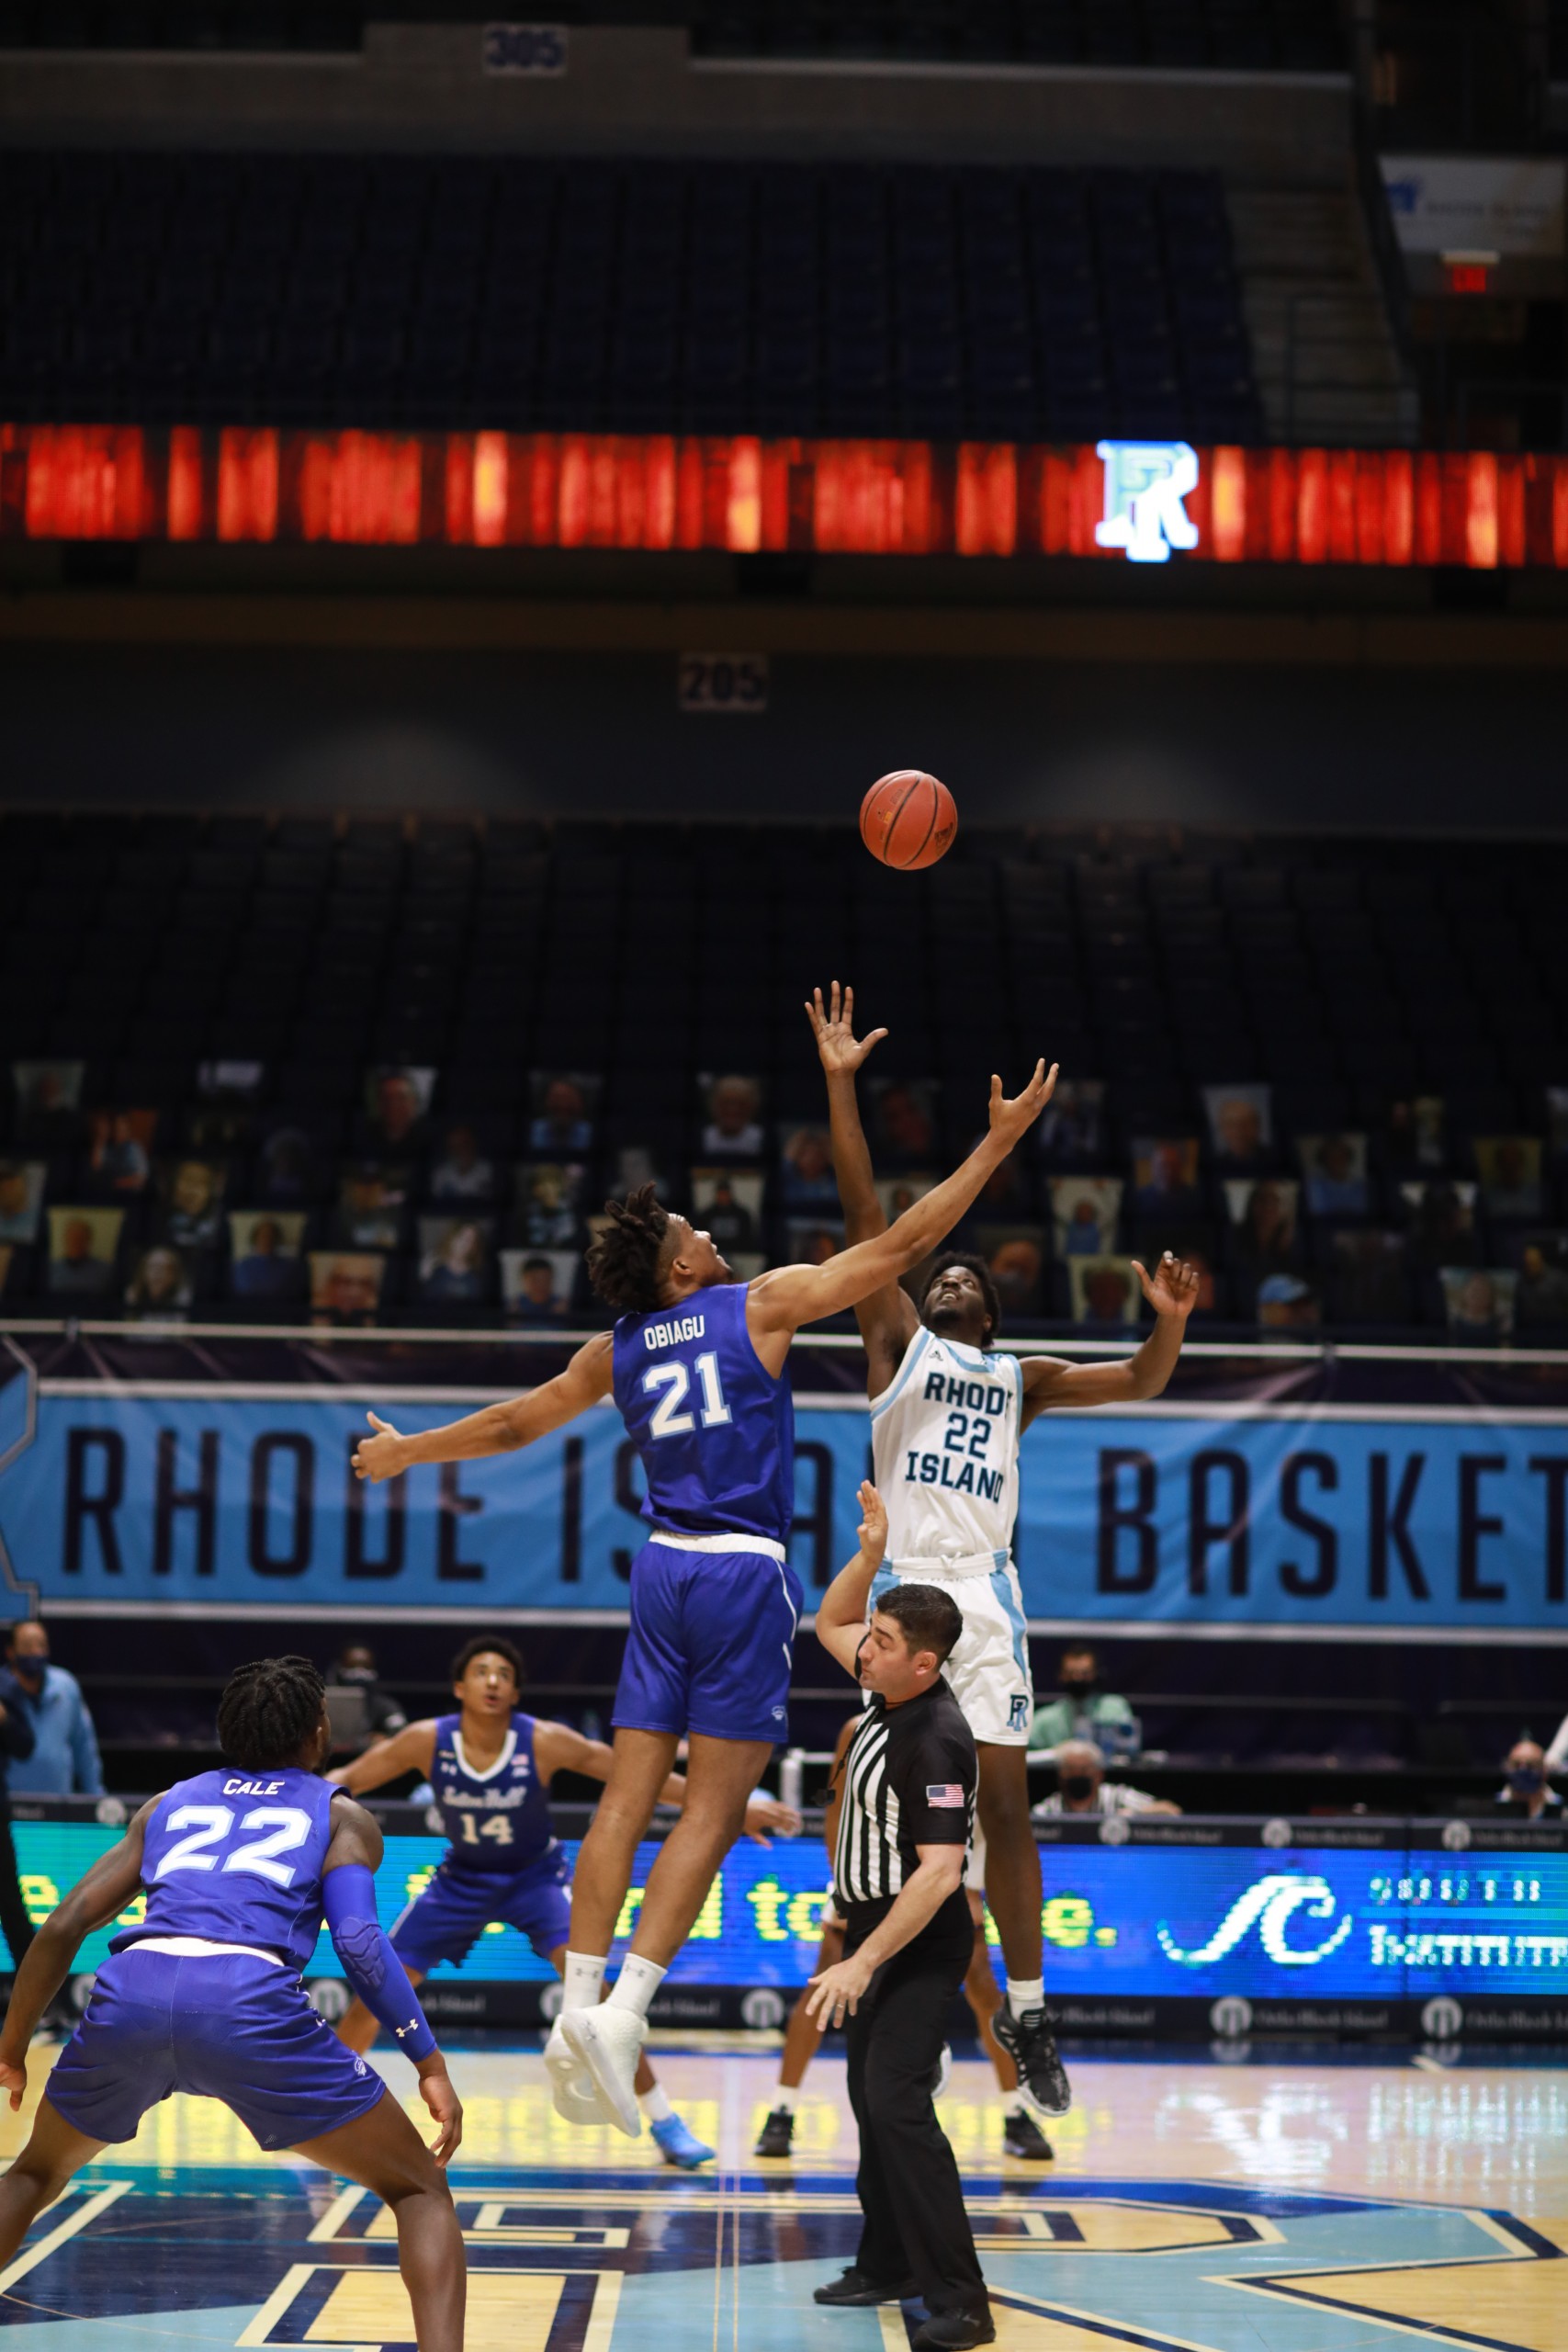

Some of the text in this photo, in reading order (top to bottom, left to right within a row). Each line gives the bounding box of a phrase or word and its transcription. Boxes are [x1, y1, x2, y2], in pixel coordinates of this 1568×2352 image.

[485, 29, 565, 68] 305
[682, 661, 763, 702] 205
[643, 1315, 705, 1351] OBIAGU
[641, 1351, 734, 1440] 21
[943, 1411, 992, 1462] 22
[62, 1428, 486, 1581] RHODE
[1094, 1446, 1568, 1603] BASKET
[222, 1778, 286, 1795] CALE
[152, 1804, 313, 1889] 22
[460, 1812, 514, 1846] 14
